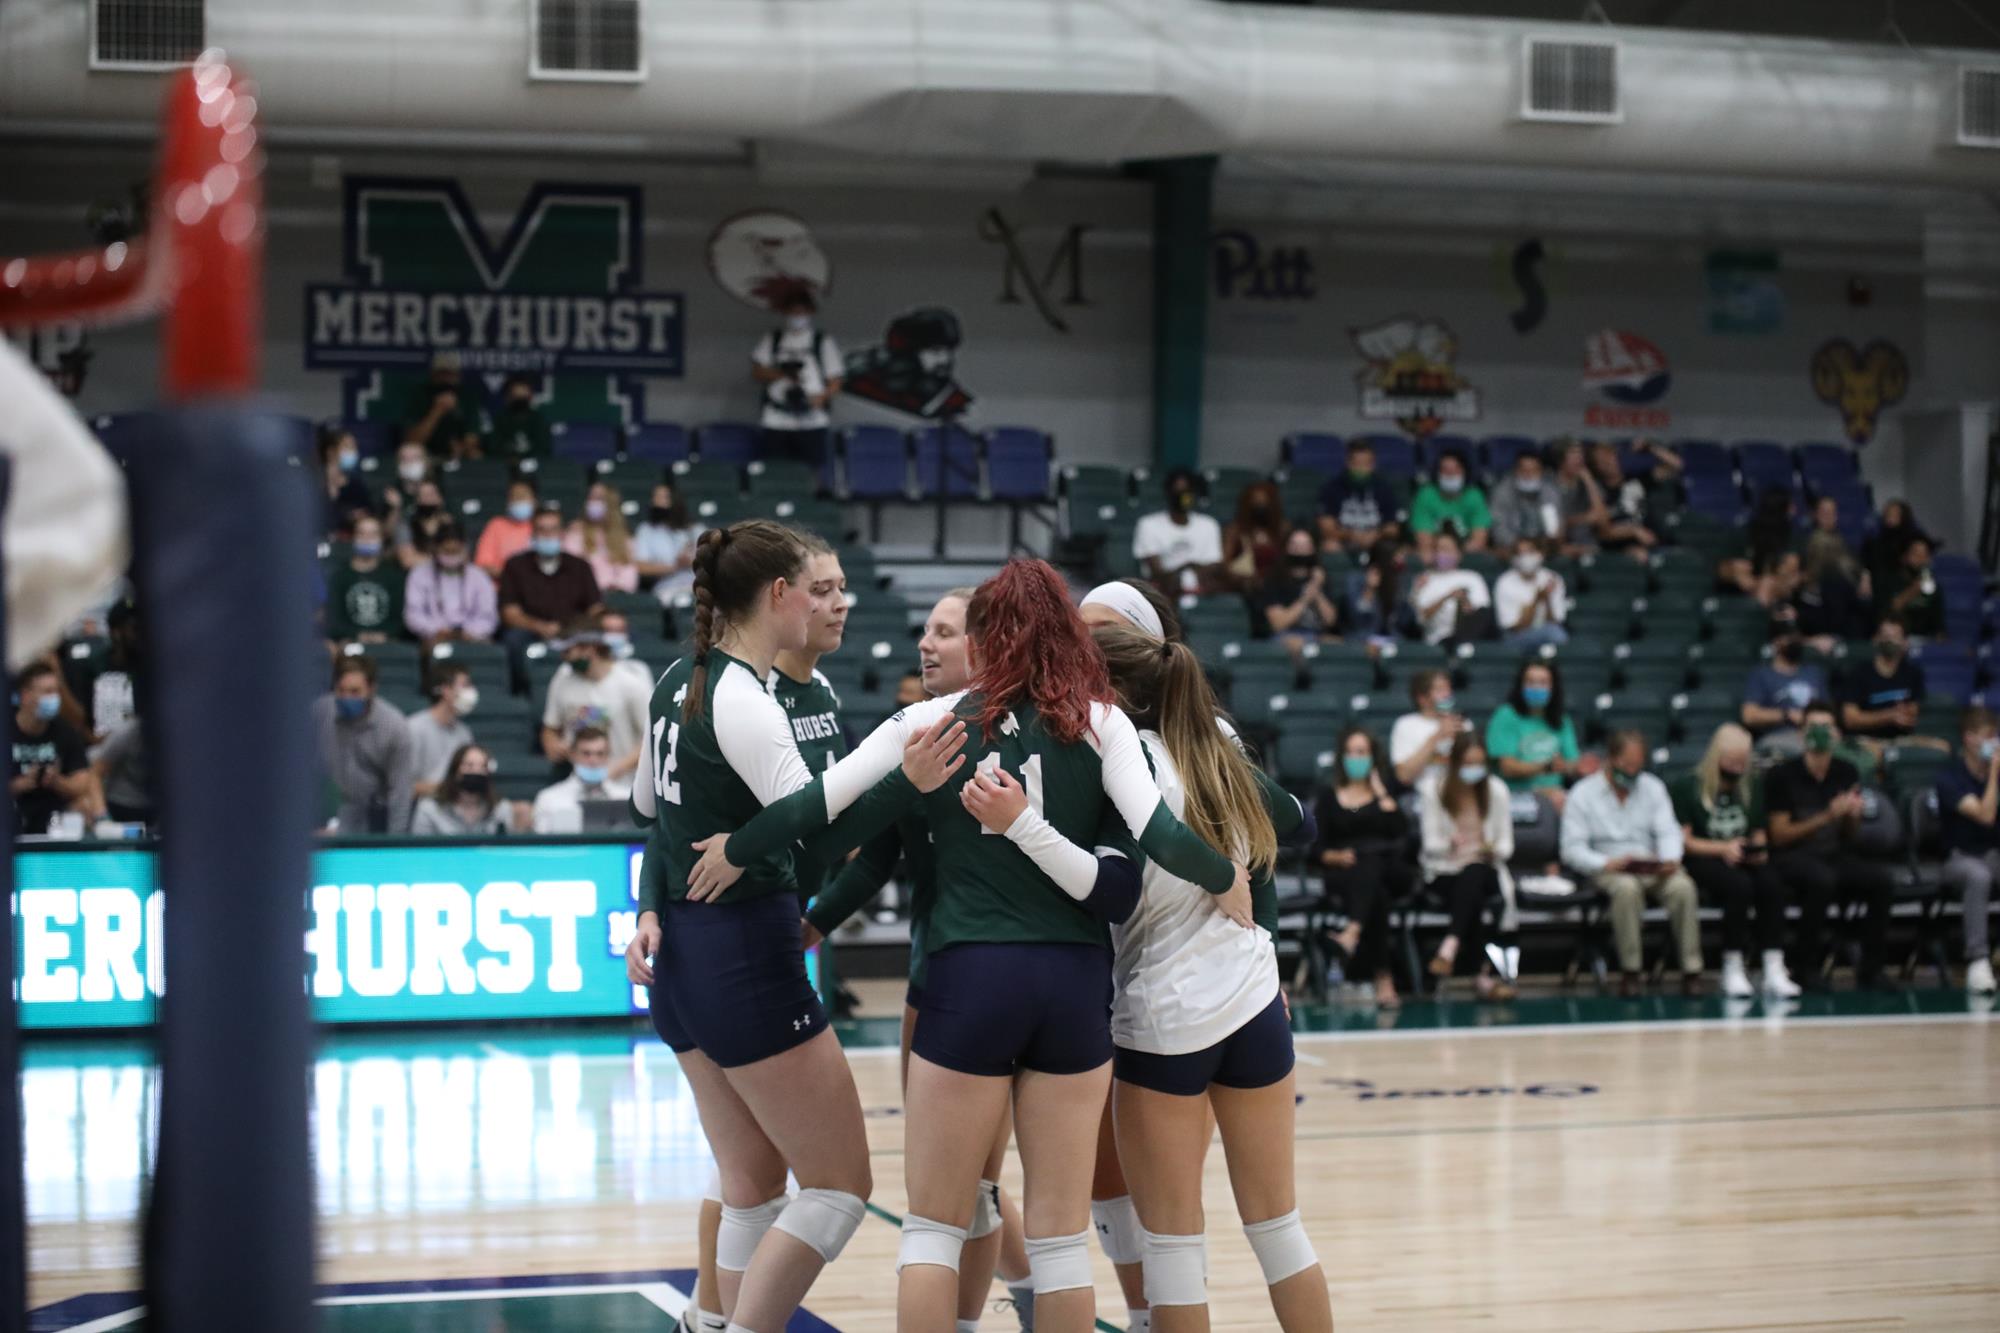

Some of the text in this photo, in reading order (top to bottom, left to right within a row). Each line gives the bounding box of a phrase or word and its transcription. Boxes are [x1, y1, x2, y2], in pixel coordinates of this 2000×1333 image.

[313, 292, 677, 354] MERCYHURST
[791, 711, 840, 742] HURST
[652, 715, 682, 806] 12
